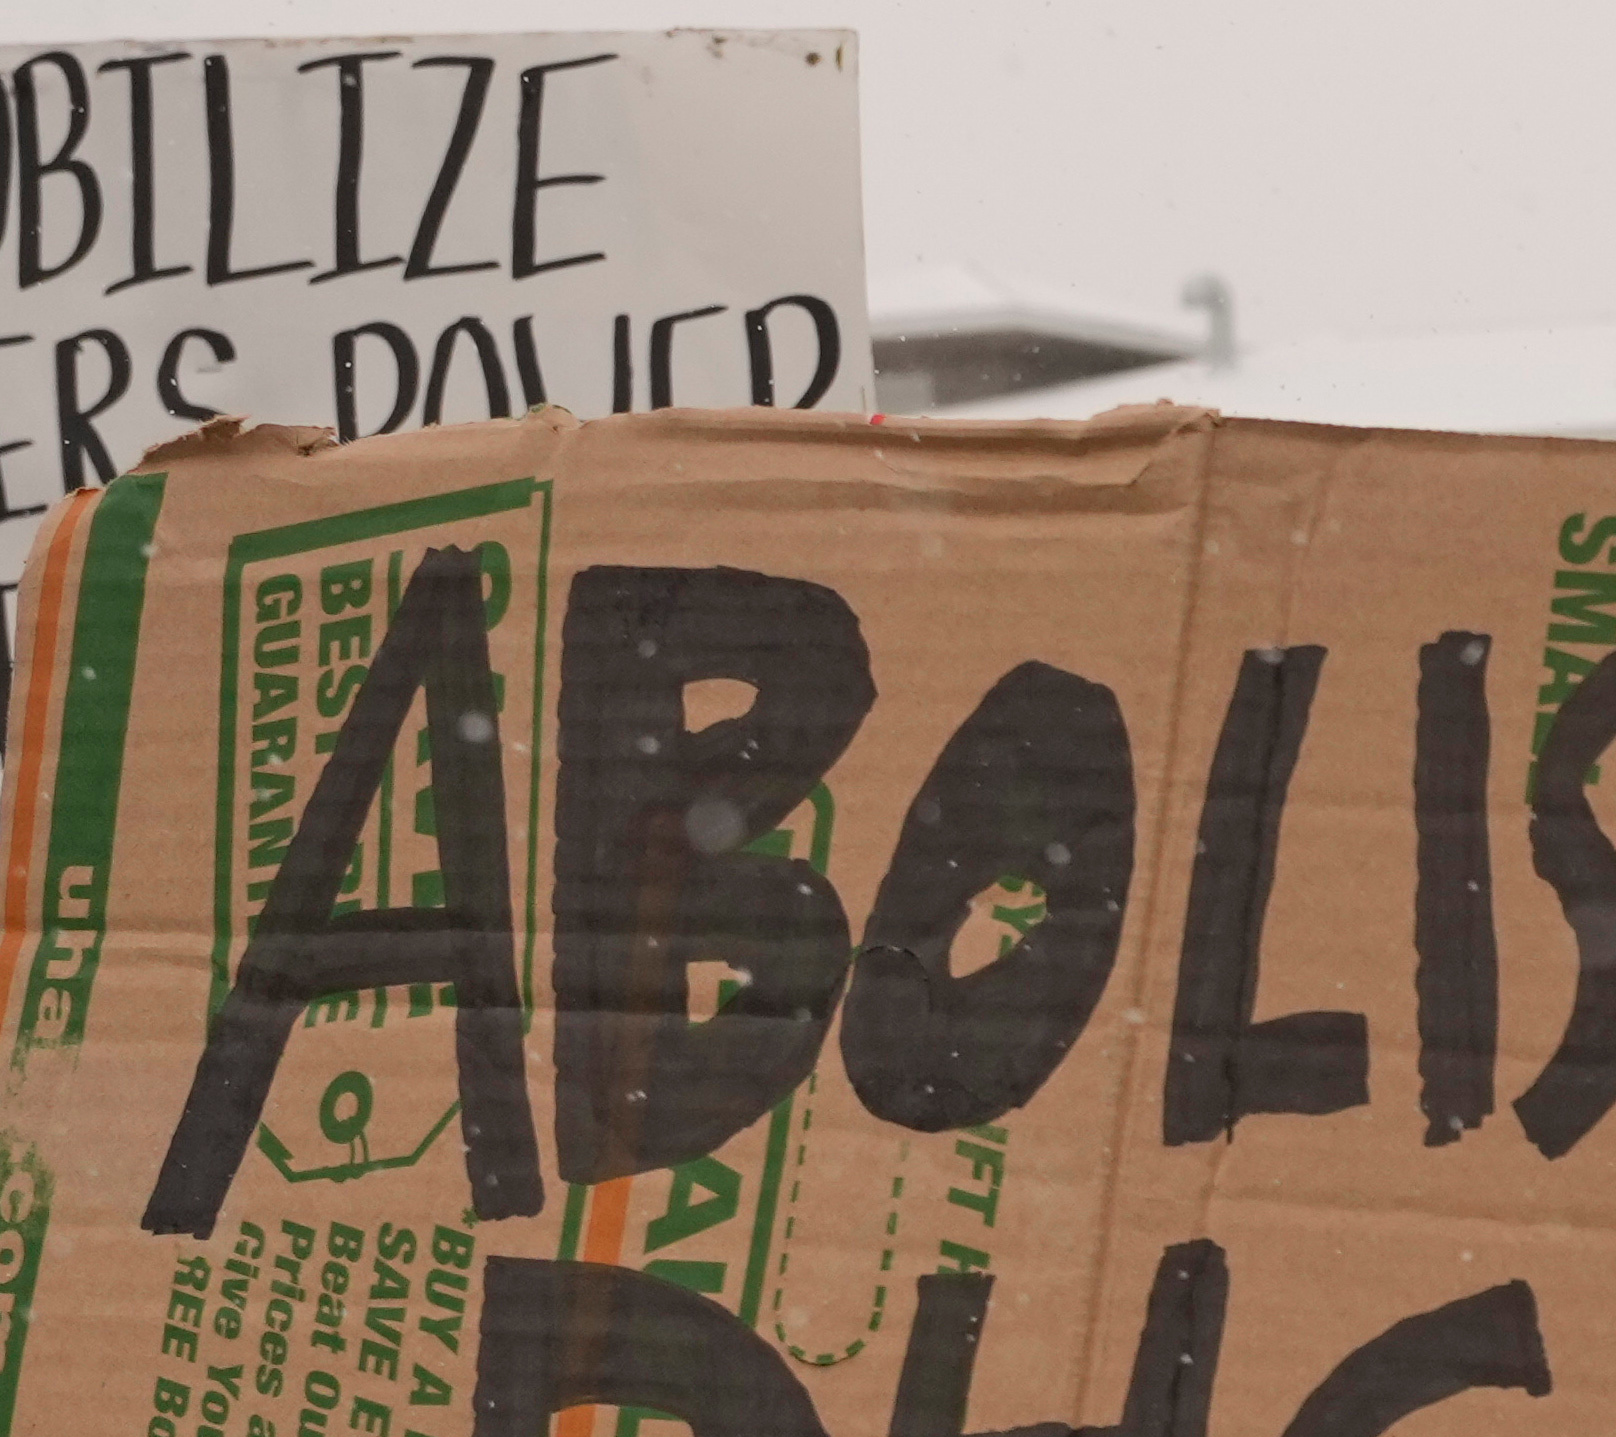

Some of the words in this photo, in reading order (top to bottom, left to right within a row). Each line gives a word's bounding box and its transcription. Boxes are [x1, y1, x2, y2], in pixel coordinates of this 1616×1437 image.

[0, 51, 618, 296] BILIZE
[161, 1253, 213, 1364] REE
[255, 1218, 316, 1399] Prices
[310, 1220, 366, 1354] Beat
[358, 1220, 418, 1383] SAVE
[408, 1362, 454, 1408] A
